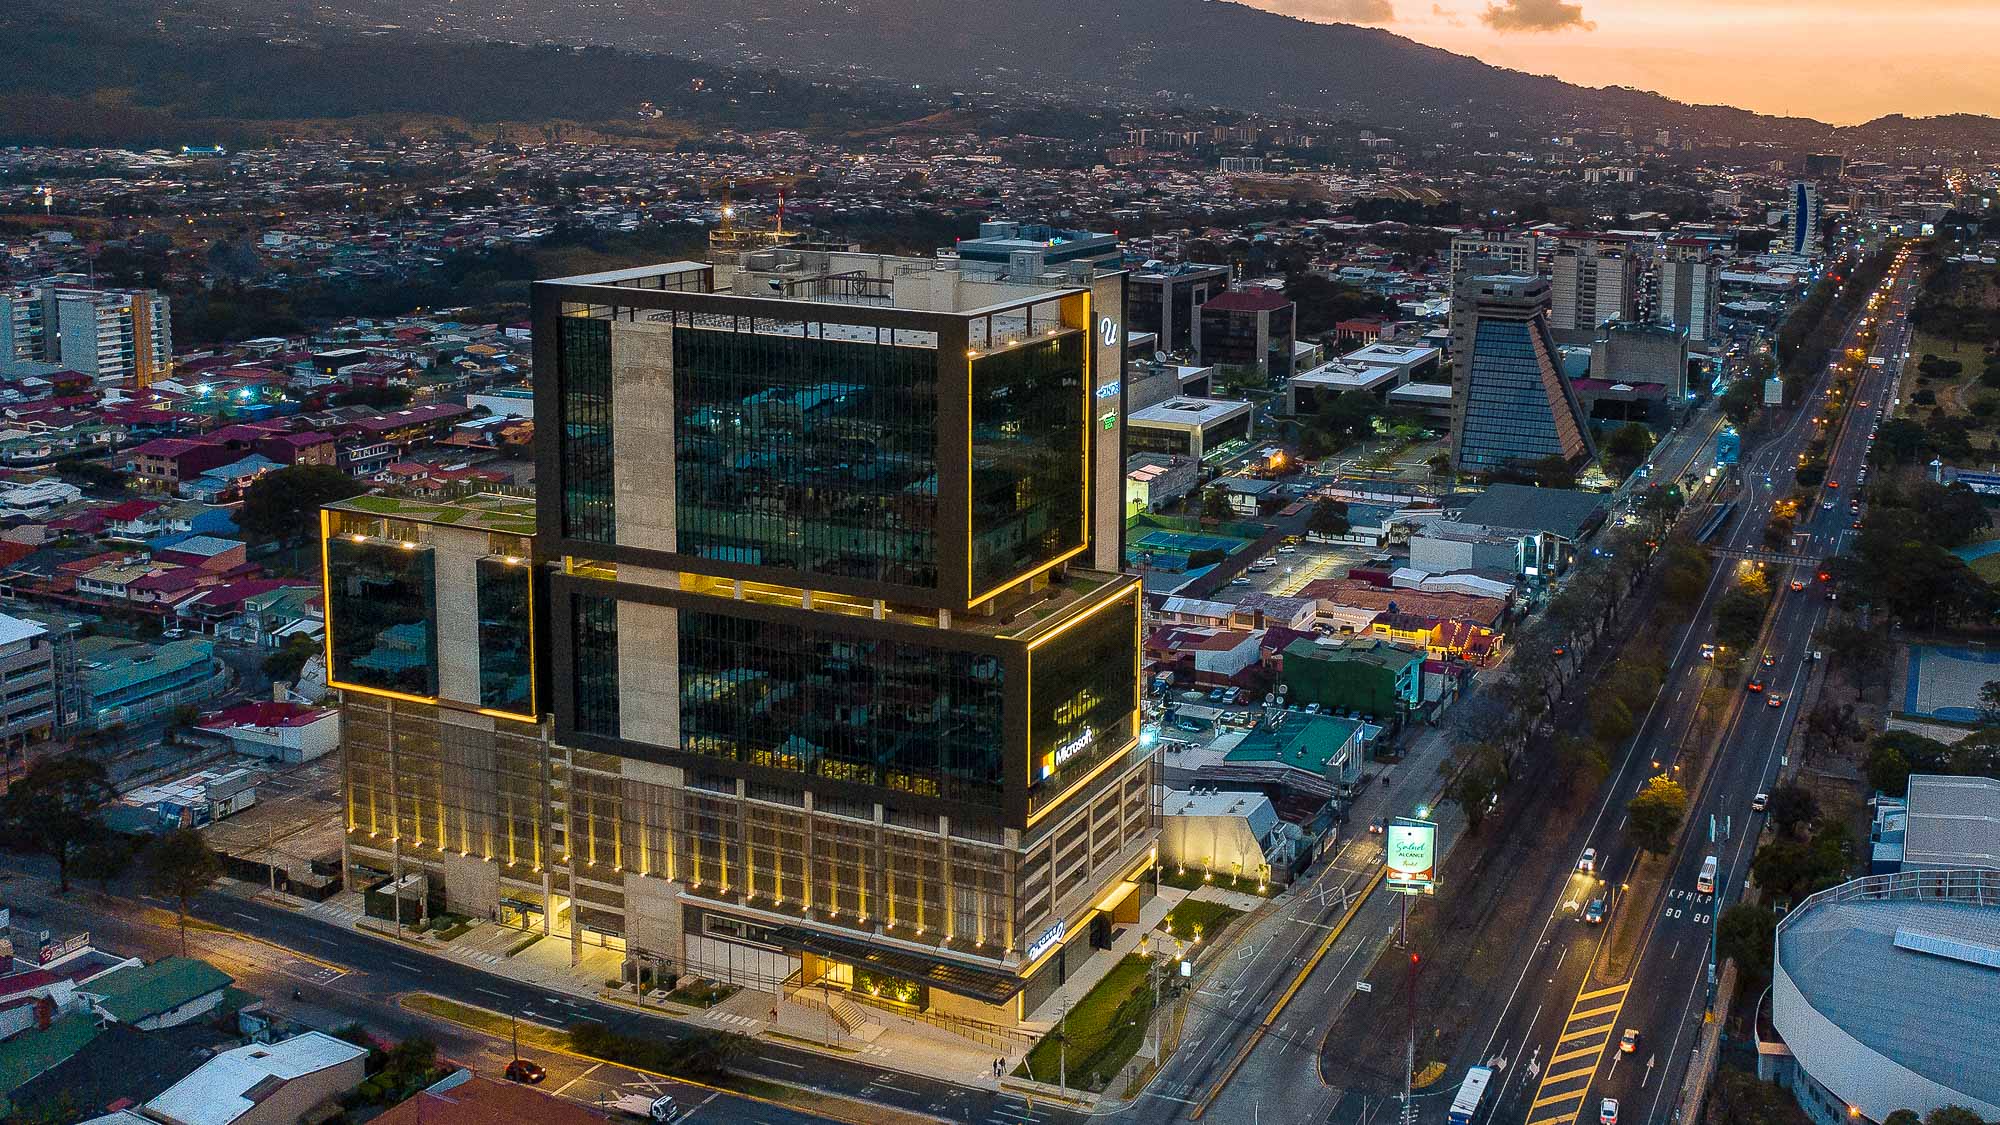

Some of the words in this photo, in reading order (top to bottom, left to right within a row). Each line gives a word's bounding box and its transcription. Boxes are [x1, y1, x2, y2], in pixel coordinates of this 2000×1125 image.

[1056, 729, 1092, 766] Microsoft
[1668, 889, 1693, 901] KPH
[1666, 908, 1682, 918] 80
[1694, 913, 1710, 924] 80
